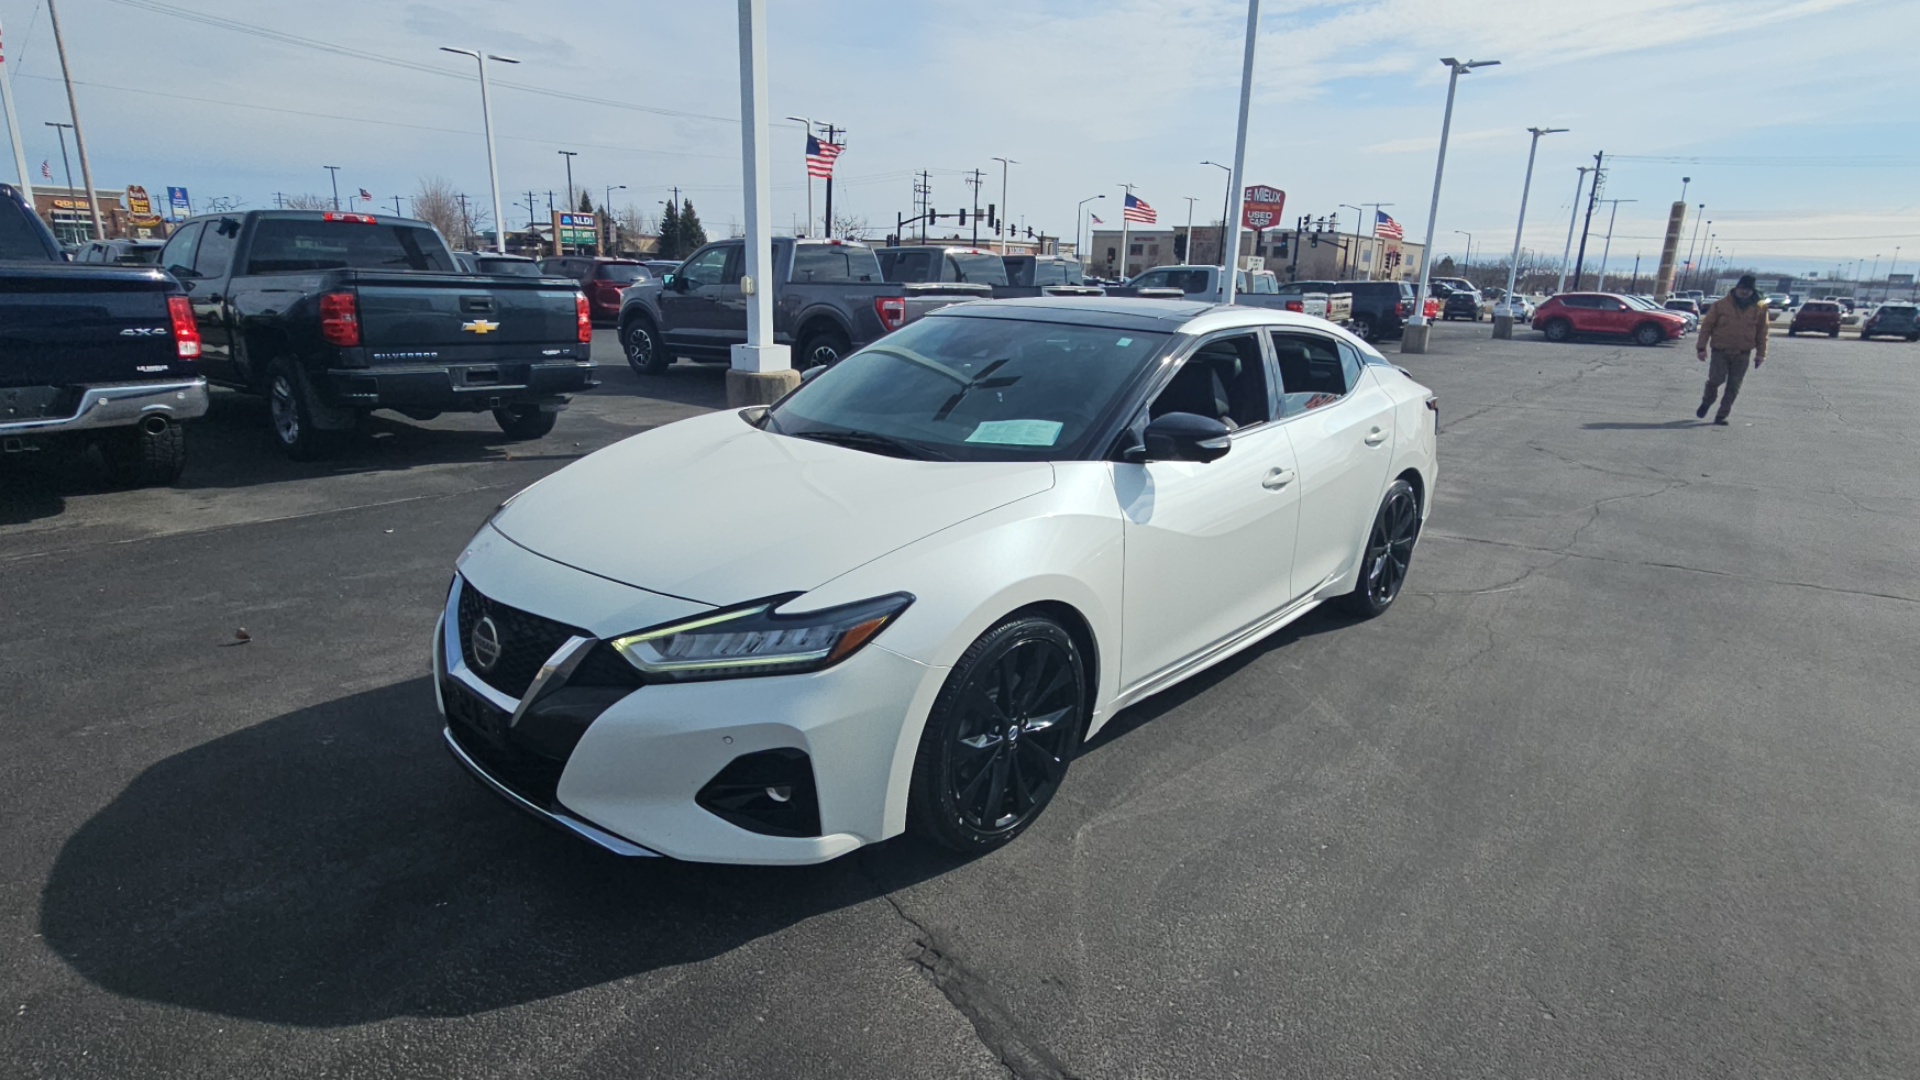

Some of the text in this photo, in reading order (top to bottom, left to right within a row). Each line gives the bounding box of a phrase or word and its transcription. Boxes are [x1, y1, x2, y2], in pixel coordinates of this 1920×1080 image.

[1254, 187, 1281, 203] MIEUX
[1247, 210, 1273, 220] USED
[1249, 219, 1270, 227] CARS
[373, 352, 438, 360] SILVERADO
